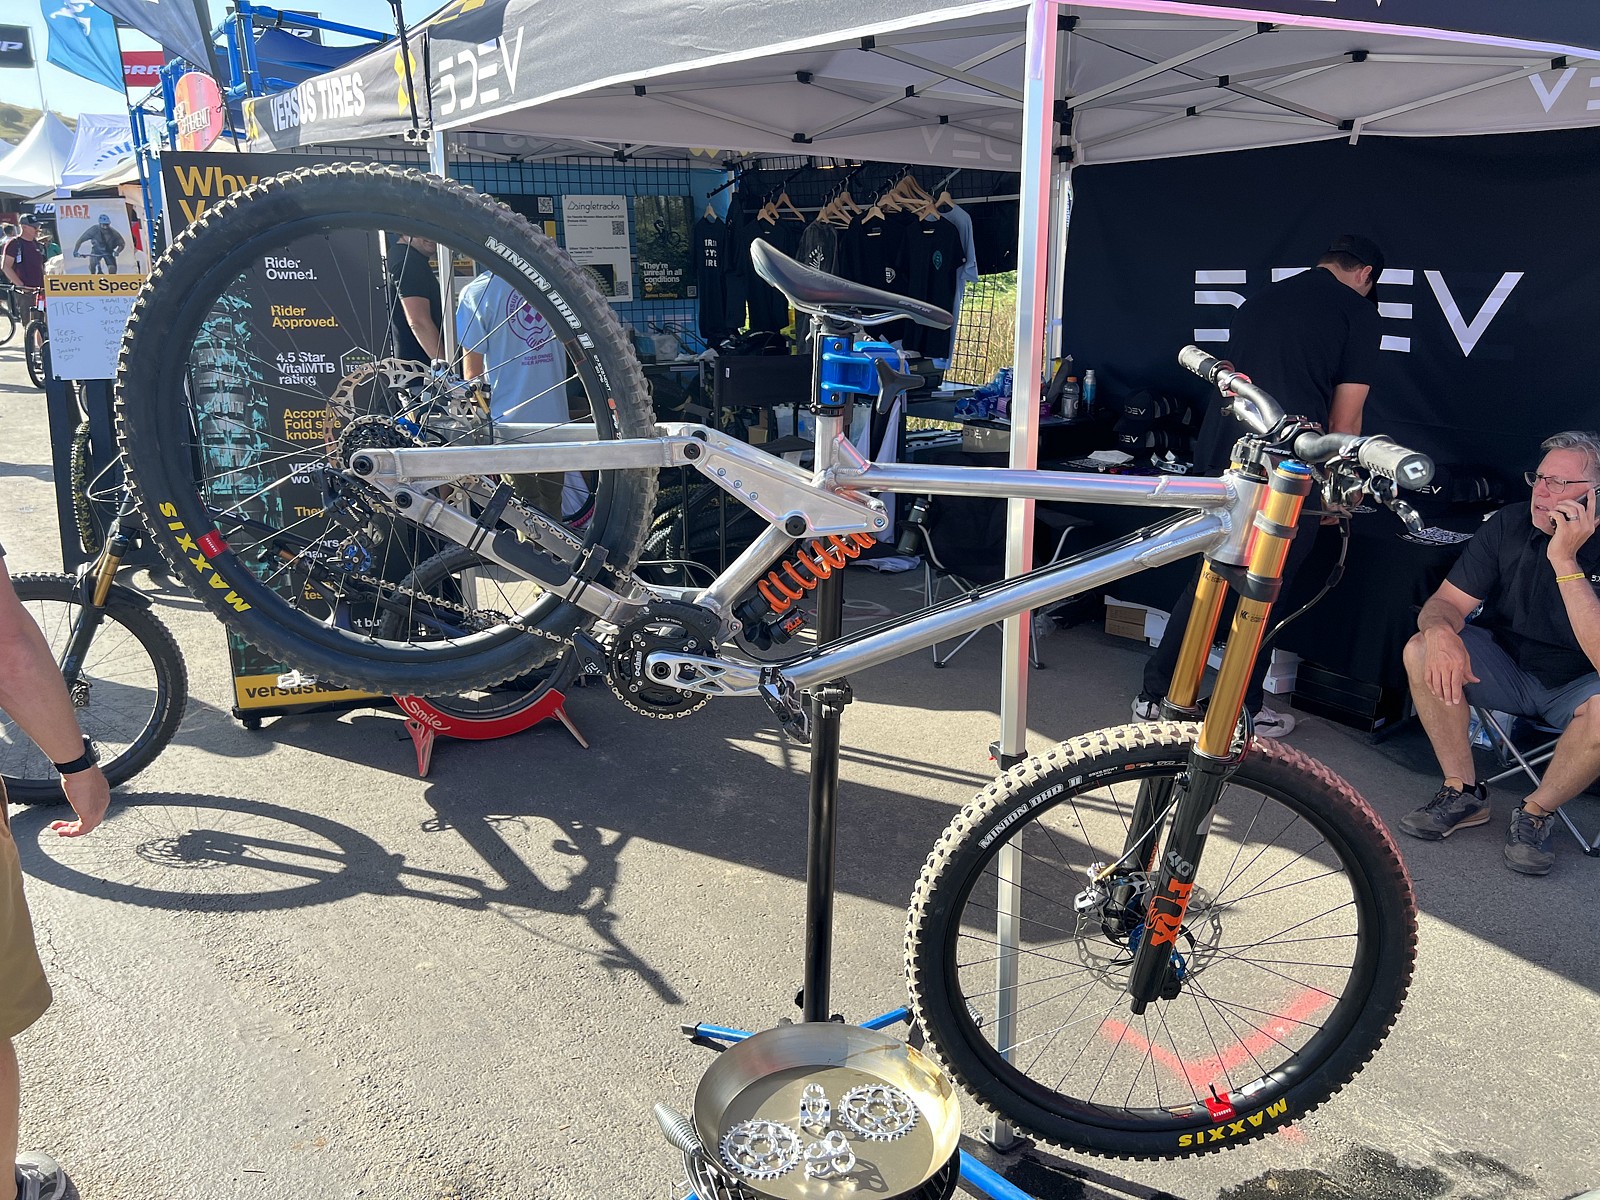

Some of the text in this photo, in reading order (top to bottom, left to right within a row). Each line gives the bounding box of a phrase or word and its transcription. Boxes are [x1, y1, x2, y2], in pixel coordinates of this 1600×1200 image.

[270, 71, 366, 132] VERSUS TIRES
[34, 203, 56, 214] RID
[573, 201, 620, 213] singletracks
[265, 257, 301, 269] Rider
[485, 235, 552, 292] MINION
[266, 269, 318, 281] Owned.
[674, 268, 683, 276] all
[50, 279, 142, 293] Event Speci
[50, 301, 96, 317] TIRES
[271, 305, 306, 317] Rider
[272, 317, 339, 329] Approved.
[276, 352, 326, 363] 4.5 Star
[277, 363, 336, 374] VitalMTB
[279, 374, 316, 386] rating
[285, 420, 313, 430] Fold
[286, 430, 324, 441] knobs
[159, 502, 252, 613] MAXXIS
[402, 697, 451, 730] Smile
[977, 802, 1029, 849] MINION
[1167, 850, 1194, 877] 40
[1144, 877, 1195, 947] FOX
[1177, 1097, 1288, 1148] MAXXIS
